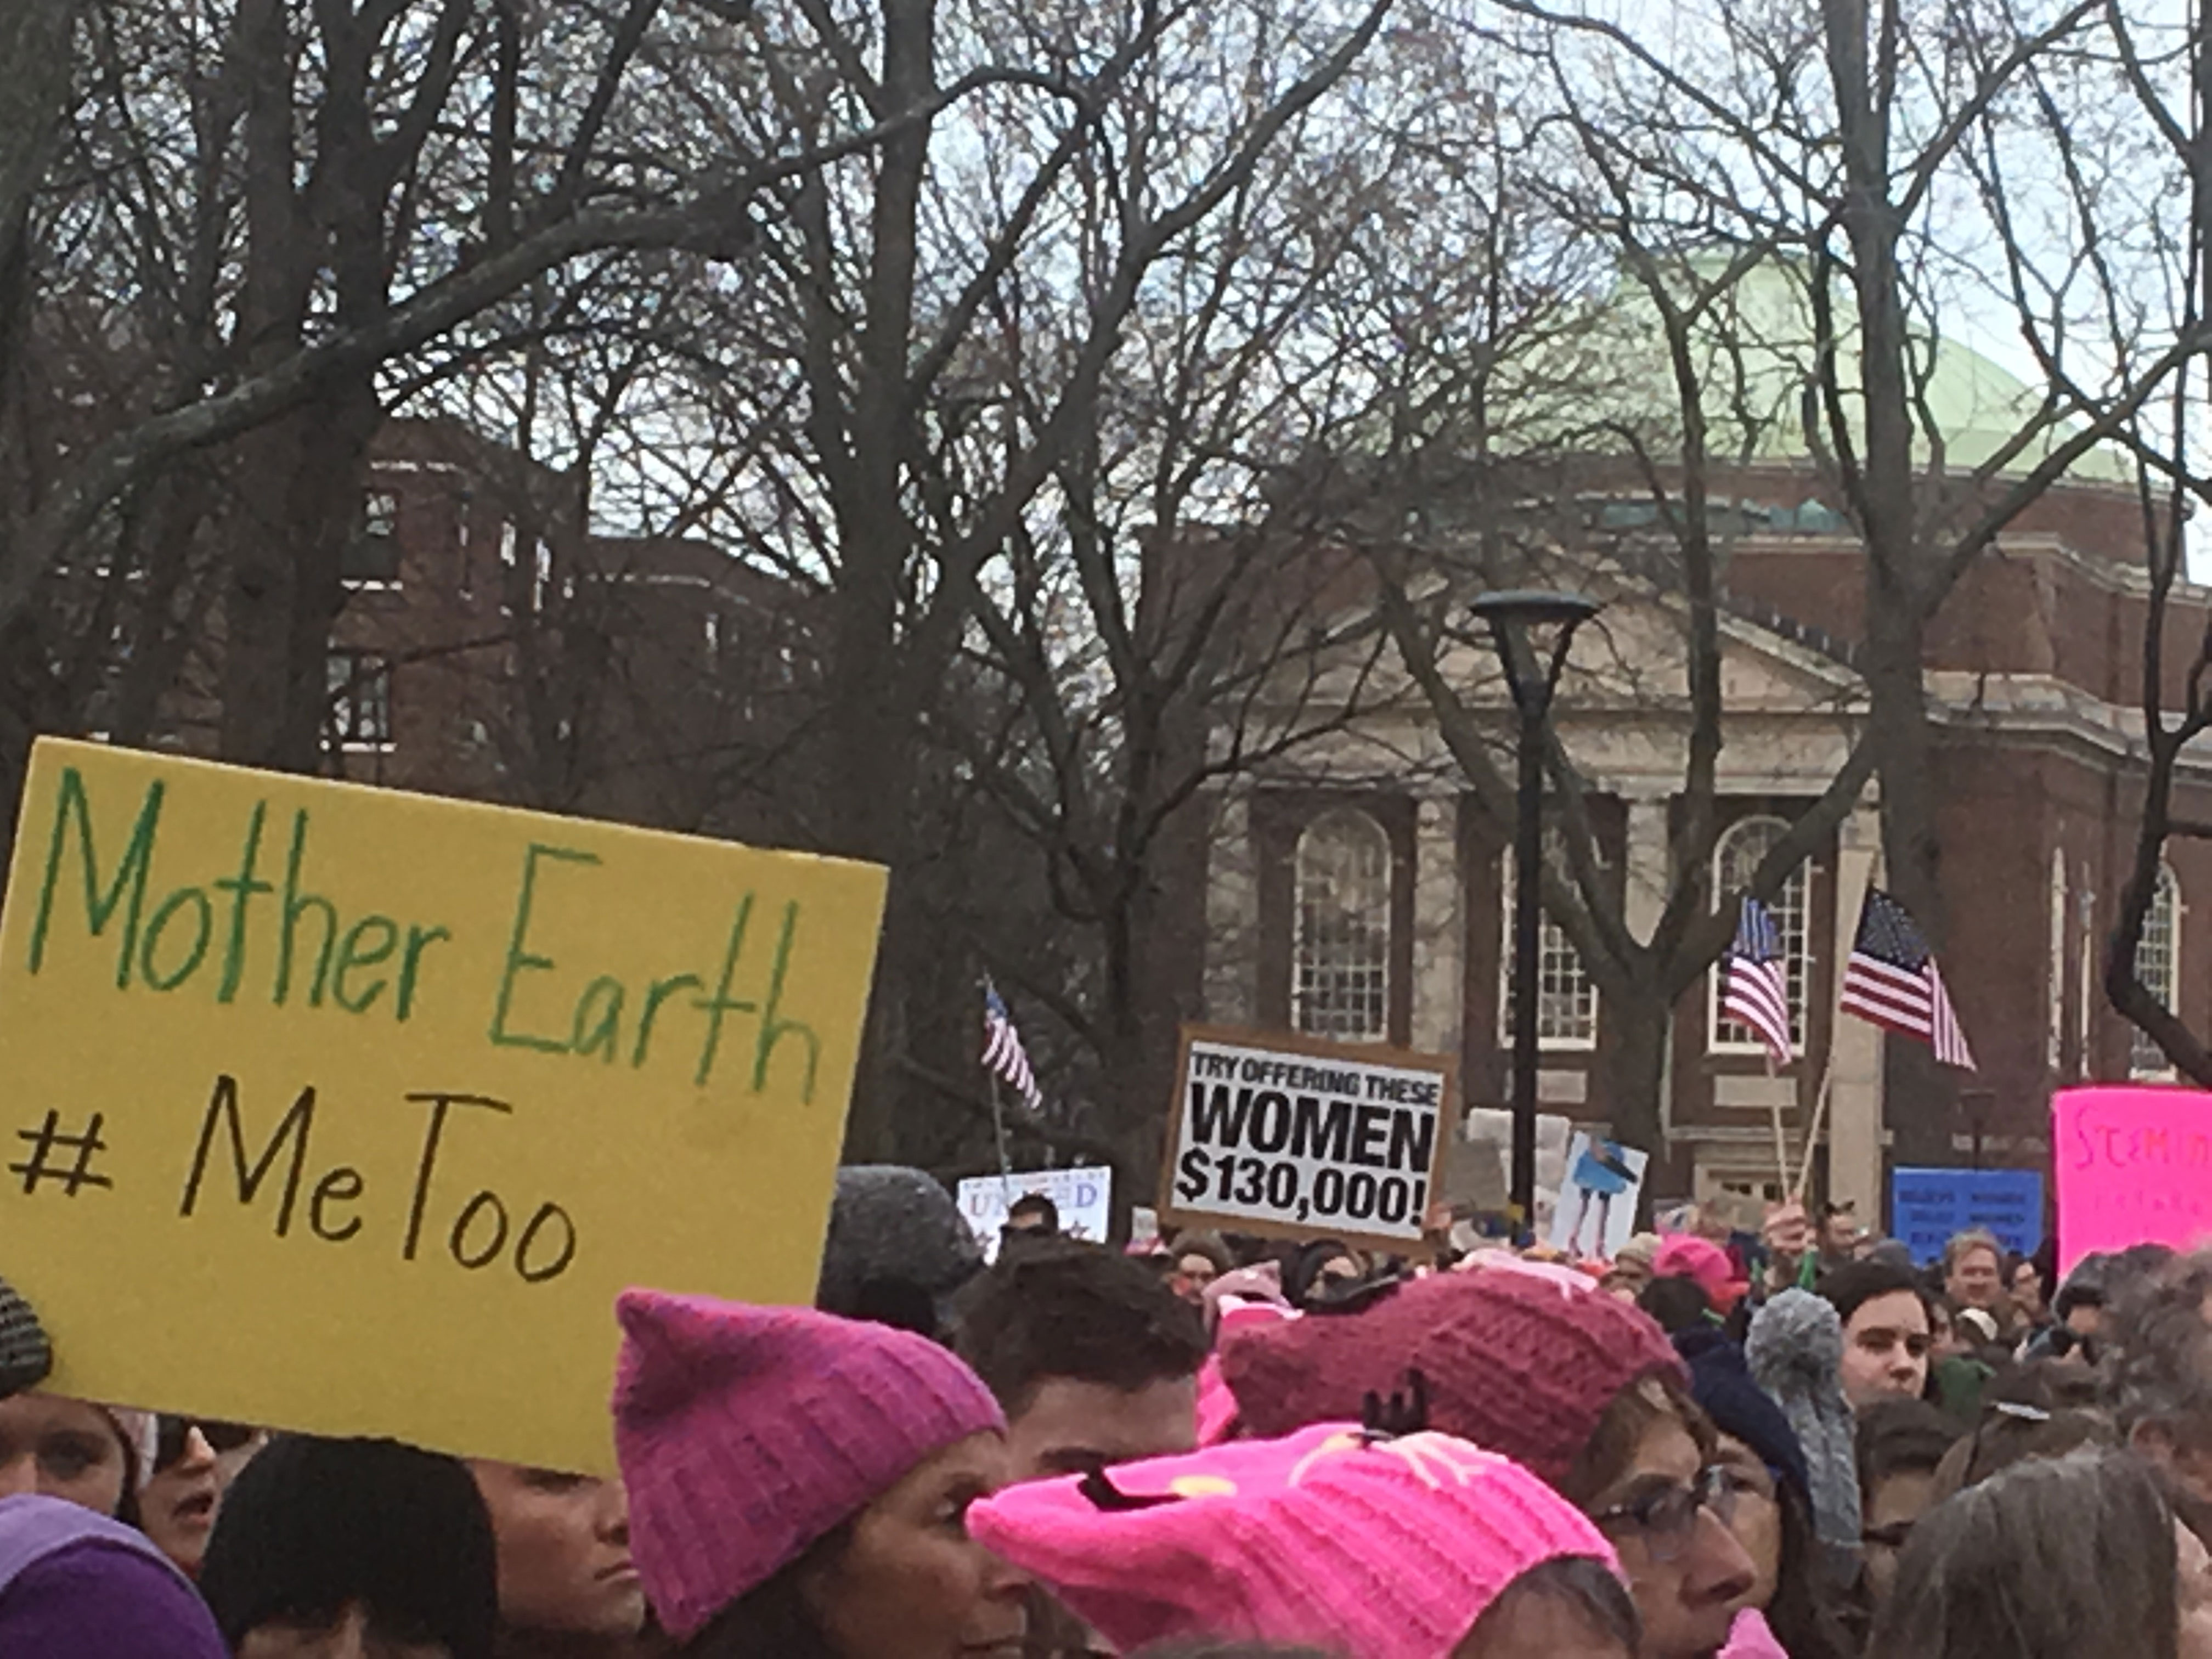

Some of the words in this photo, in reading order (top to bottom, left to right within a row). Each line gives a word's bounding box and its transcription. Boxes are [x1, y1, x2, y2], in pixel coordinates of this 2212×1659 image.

[29, 768, 452, 1023] Mother
[489, 843, 821, 1105] Earth
[1191, 1051, 1239, 1079] TRY
[1241, 1058, 1361, 1096] OFFERING
[1365, 1074, 1440, 1107] THESE
[1190, 1082, 1435, 1172] WOMEN
[1176, 1147, 1426, 1227] $130,000!
